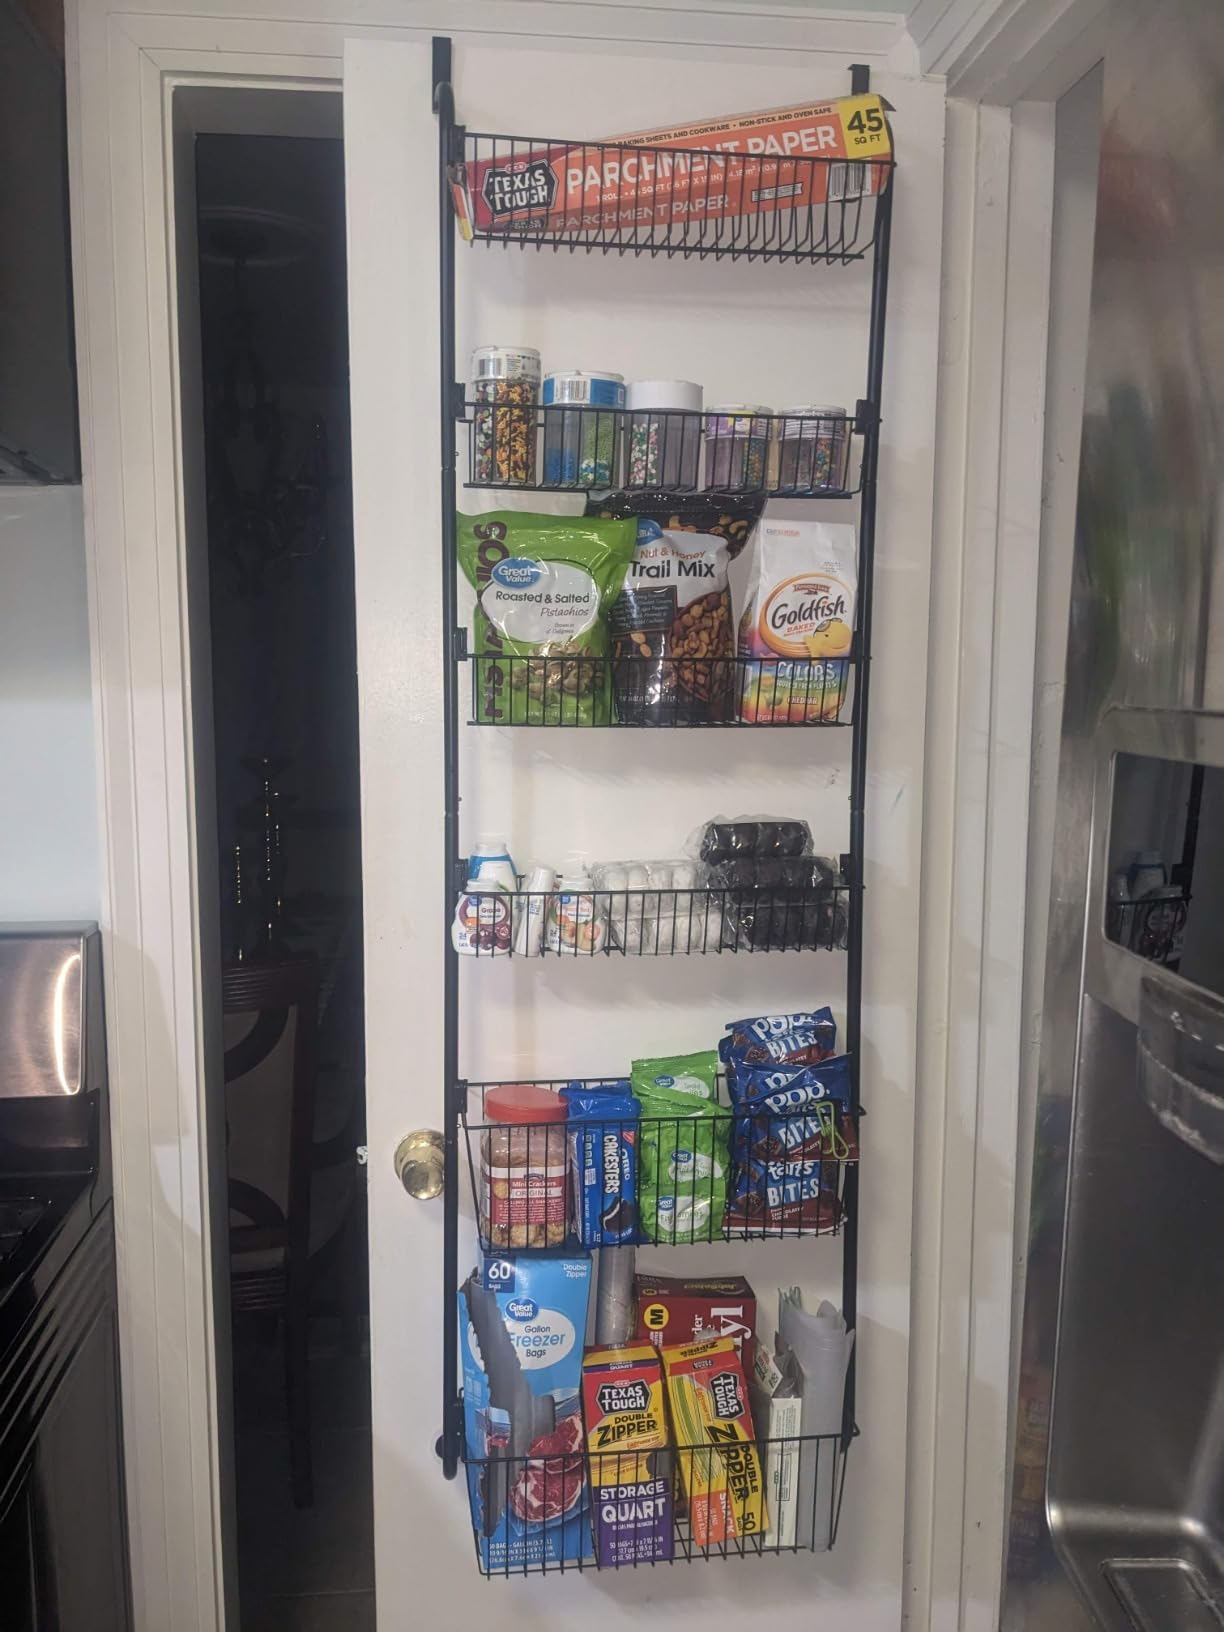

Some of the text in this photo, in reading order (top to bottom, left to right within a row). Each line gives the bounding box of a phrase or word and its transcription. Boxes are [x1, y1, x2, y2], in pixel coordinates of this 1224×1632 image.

[645, 134, 672, 142] SHEETS
[673, 130, 688, 138] AND
[689, 124, 730, 135] COOKWARE
[738, 116, 777, 127] NON-STICK
[777, 114, 793, 123] AND
[793, 110, 813, 119] OVEN
[814, 107, 833, 115] SAFE
[847, 108, 883, 134] 45
[854, 133, 881, 145] SQ FT
[566, 140, 740, 194] PARCHMENT
[746, 125, 838, 162] PAPER
[489, 169, 546, 192] TEXAS
[489, 185, 548, 211] TOUGH
[672, 194, 728, 216] PAPER
[640, 547, 658, 559] Nut
[660, 547, 669, 556] &
[498, 564, 532, 577] Great
[629, 559, 716, 578] Trail Mix
[505, 574, 532, 583] Value
[495, 590, 590, 604] Roasted & Salted
[540, 606, 589, 617] Pistachios
[771, 594, 845, 629] Goldfish
[786, 622, 816, 633] BAKED
[766, 1030, 818, 1059] BITES
[603, 1134, 620, 1194] CAKESTERS
[767, 1178, 820, 1207] BITES
[487, 1261, 512, 1280] 60
[562, 1263, 588, 1272] Double
[565, 1270, 587, 1279] Zipper
[509, 1302, 533, 1313] Great
[514, 1309, 533, 1318] Value
[649, 1308, 664, 1326] M
[524, 1325, 551, 1334] Gallon
[525, 1348, 547, 1358] Bags
[602, 1385, 643, 1400] TEXAS
[713, 1377, 730, 1416] TOUGH
[724, 1375, 739, 1413] TEXAS
[601, 1396, 646, 1411] TOUGH
[614, 1412, 653, 1425] DOUBLE
[597, 1420, 658, 1448] ZIPPER
[740, 1445, 759, 1494] DOUBLE
[600, 1481, 665, 1500] STORAGE
[601, 1498, 666, 1523] QUART
[743, 1511, 756, 1531] 50
